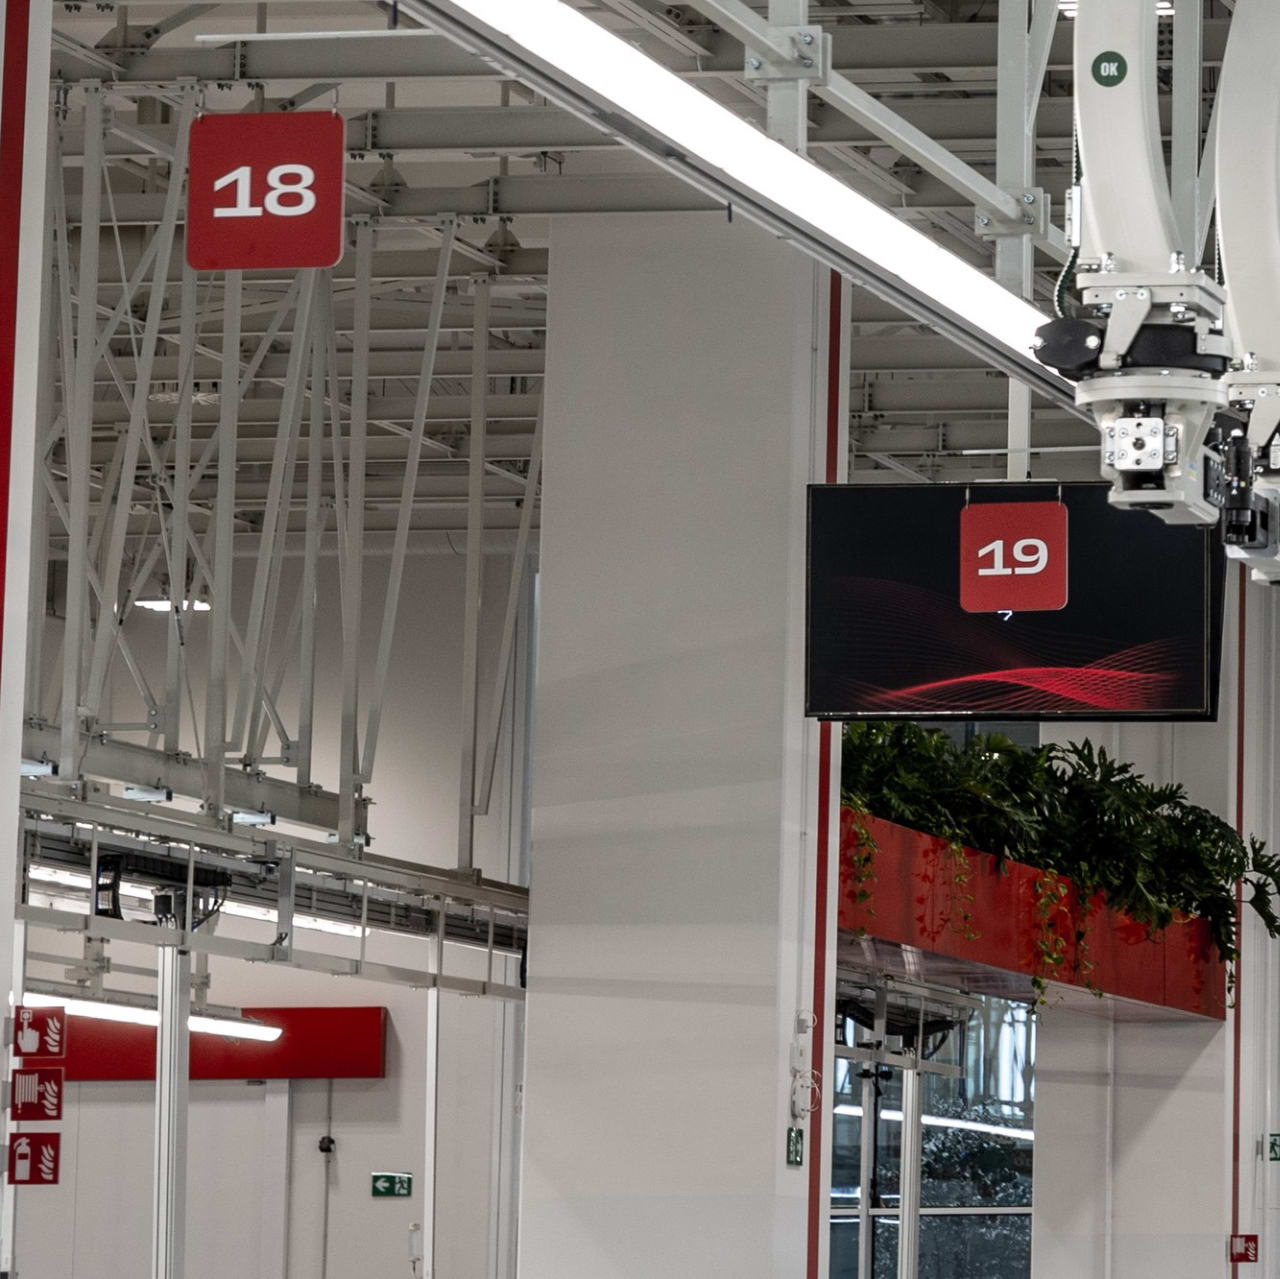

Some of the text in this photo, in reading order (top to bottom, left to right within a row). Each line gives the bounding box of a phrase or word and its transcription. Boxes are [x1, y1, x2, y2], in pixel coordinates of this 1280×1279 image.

[1100, 62, 1119, 76] OK
[213, 163, 317, 218] 18
[977, 538, 1048, 576] 19
